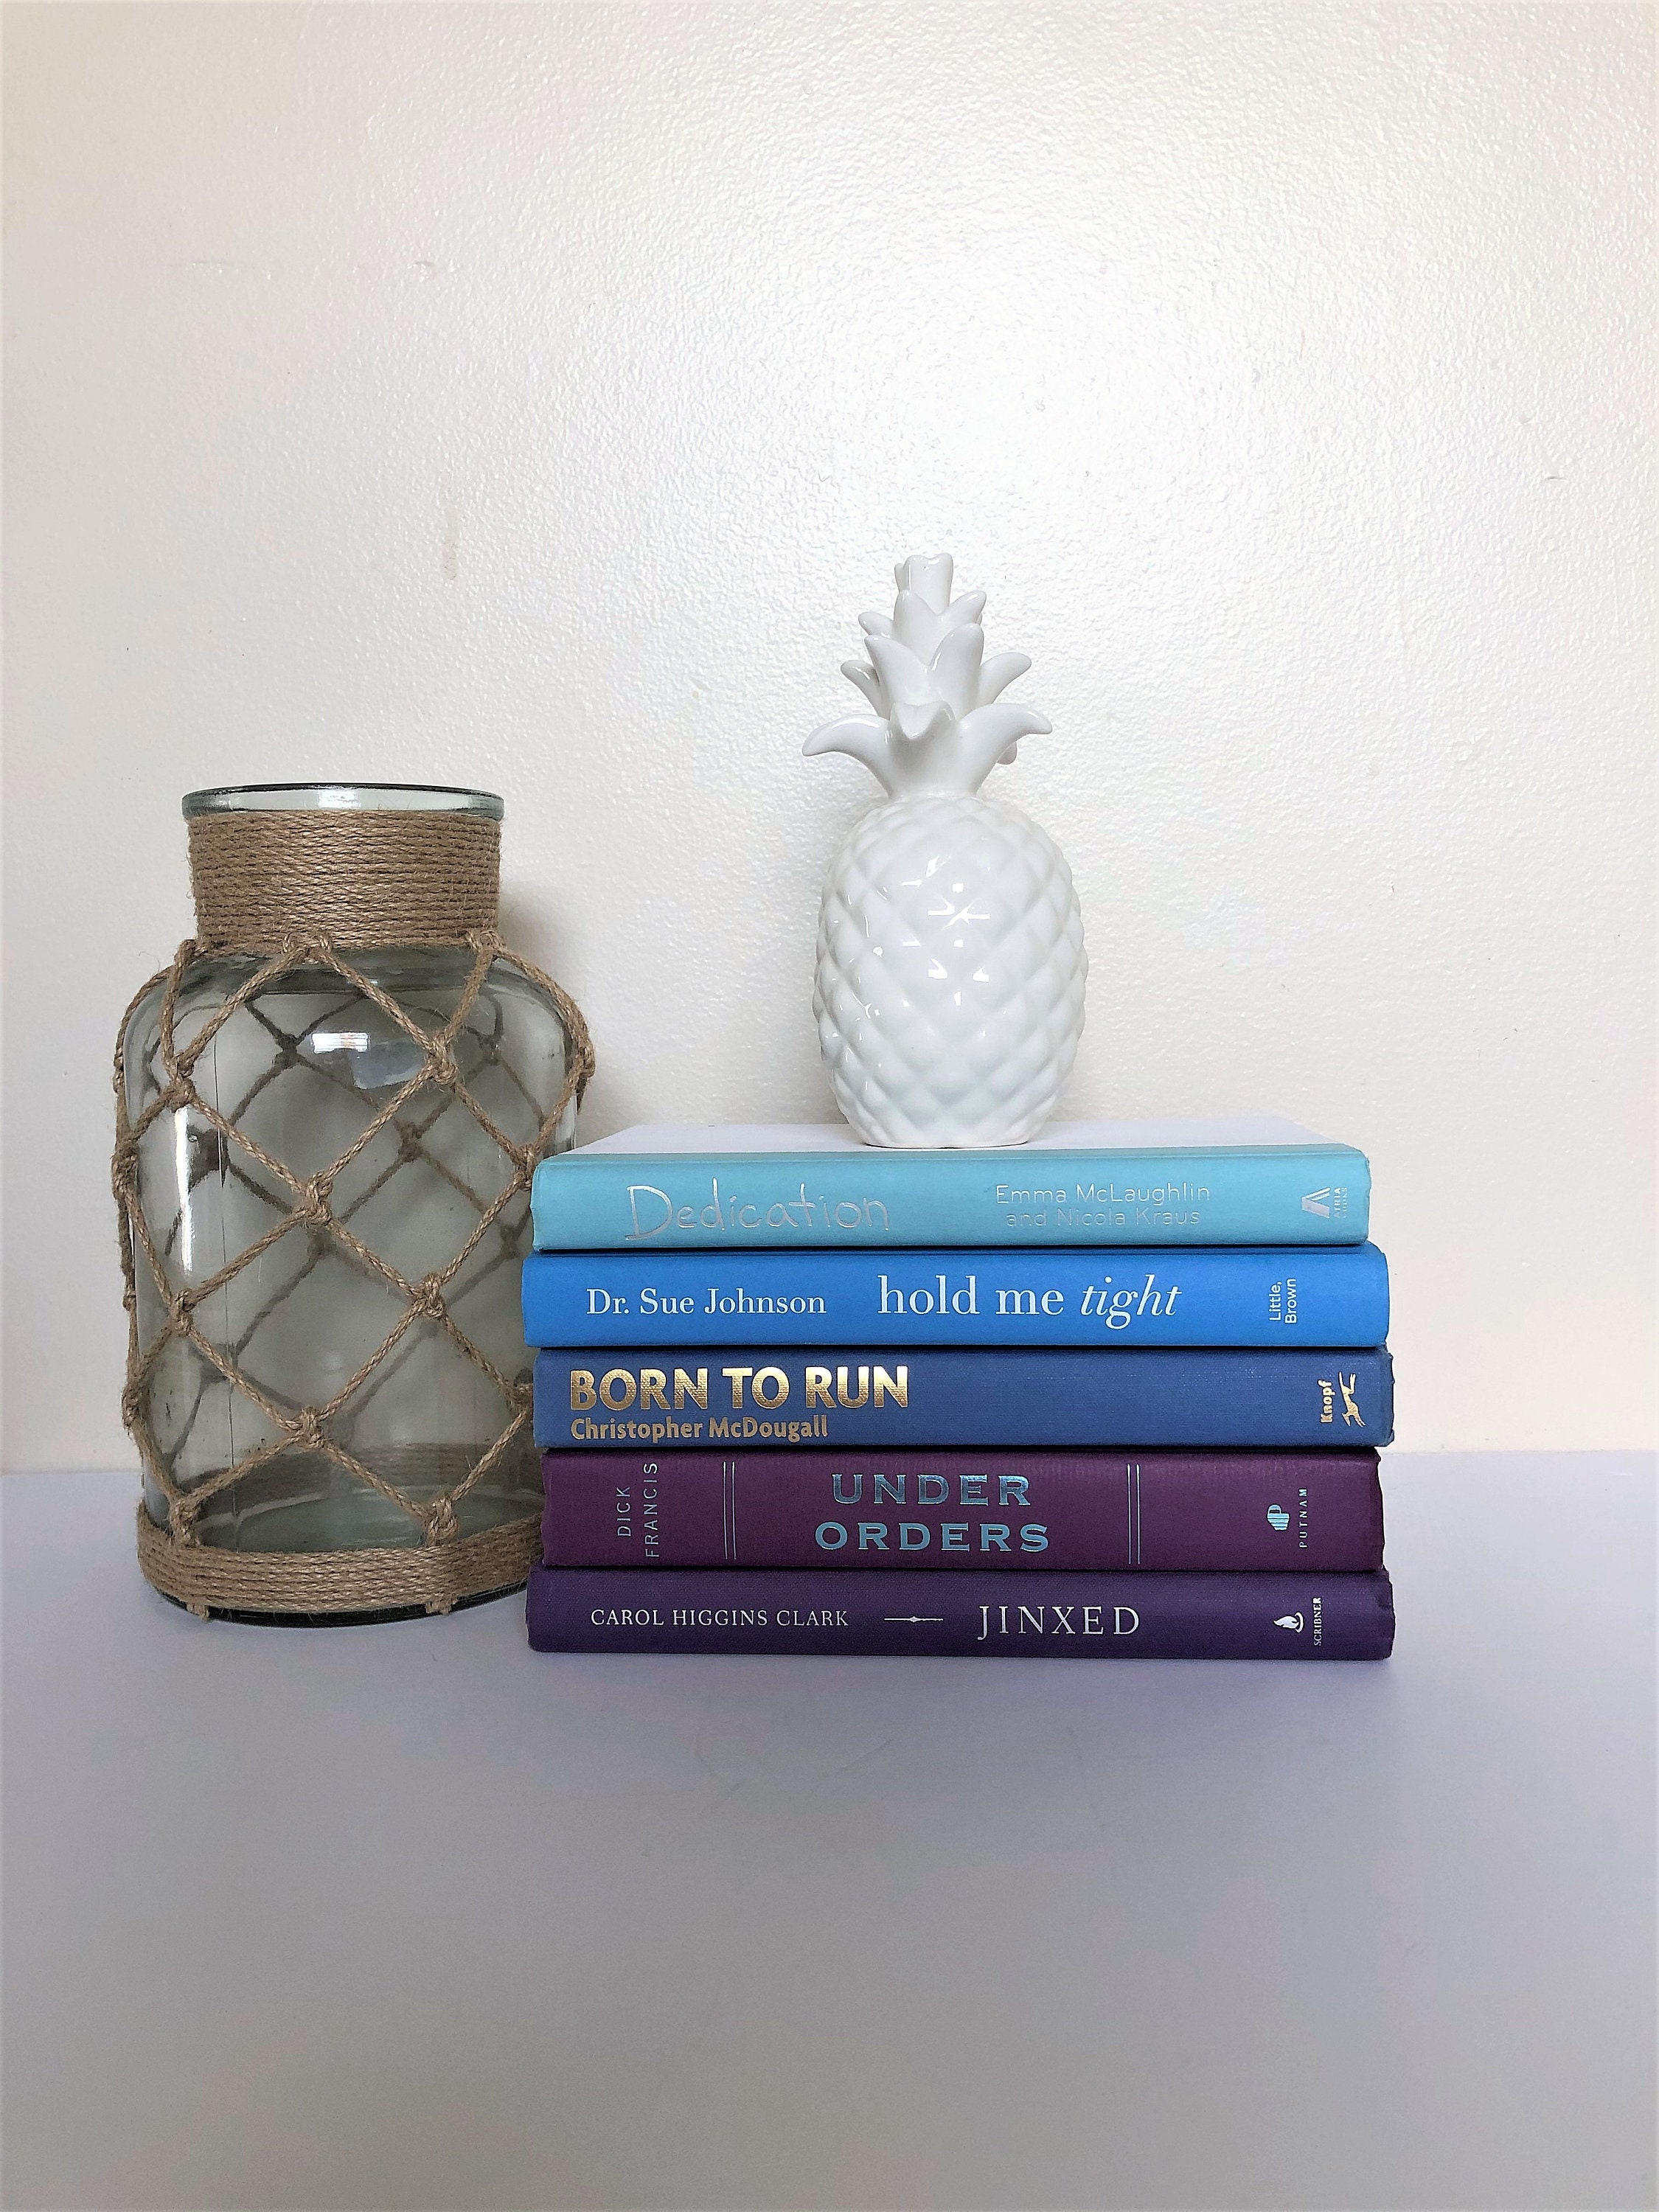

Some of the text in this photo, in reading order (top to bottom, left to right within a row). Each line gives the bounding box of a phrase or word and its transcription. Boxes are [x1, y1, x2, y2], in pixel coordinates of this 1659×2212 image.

[625, 1178, 891, 1241] Dedication
[995, 1183, 1211, 1205] Emma McLaughlin
[1006, 1207, 1201, 1227] and Nicola Kraus
[586, 1287, 827, 1315] Dr. Sue Johnson
[877, 1273, 1183, 1330] hold me tight
[1268, 1281, 1283, 1321] Little,
[1284, 1278, 1298, 1324] Brown
[569, 1365, 910, 1412] BORN TO RUN
[1317, 1379, 1336, 1424] Knopf
[571, 1414, 830, 1444] Christopher McDougall
[643, 1461, 660, 1558] FRANCIS
[832, 1472, 1032, 1506] UNDER
[615, 1485, 632, 1537] DICK
[1298, 1488, 1309, 1548] PUTNAM
[815, 1521, 1050, 1553] ORDERS
[590, 1608, 849, 1627] CAROL HIGGINS CLARK
[976, 1605, 1141, 1641] JINXED
[1312, 1596, 1323, 1646] SCRIBNER
